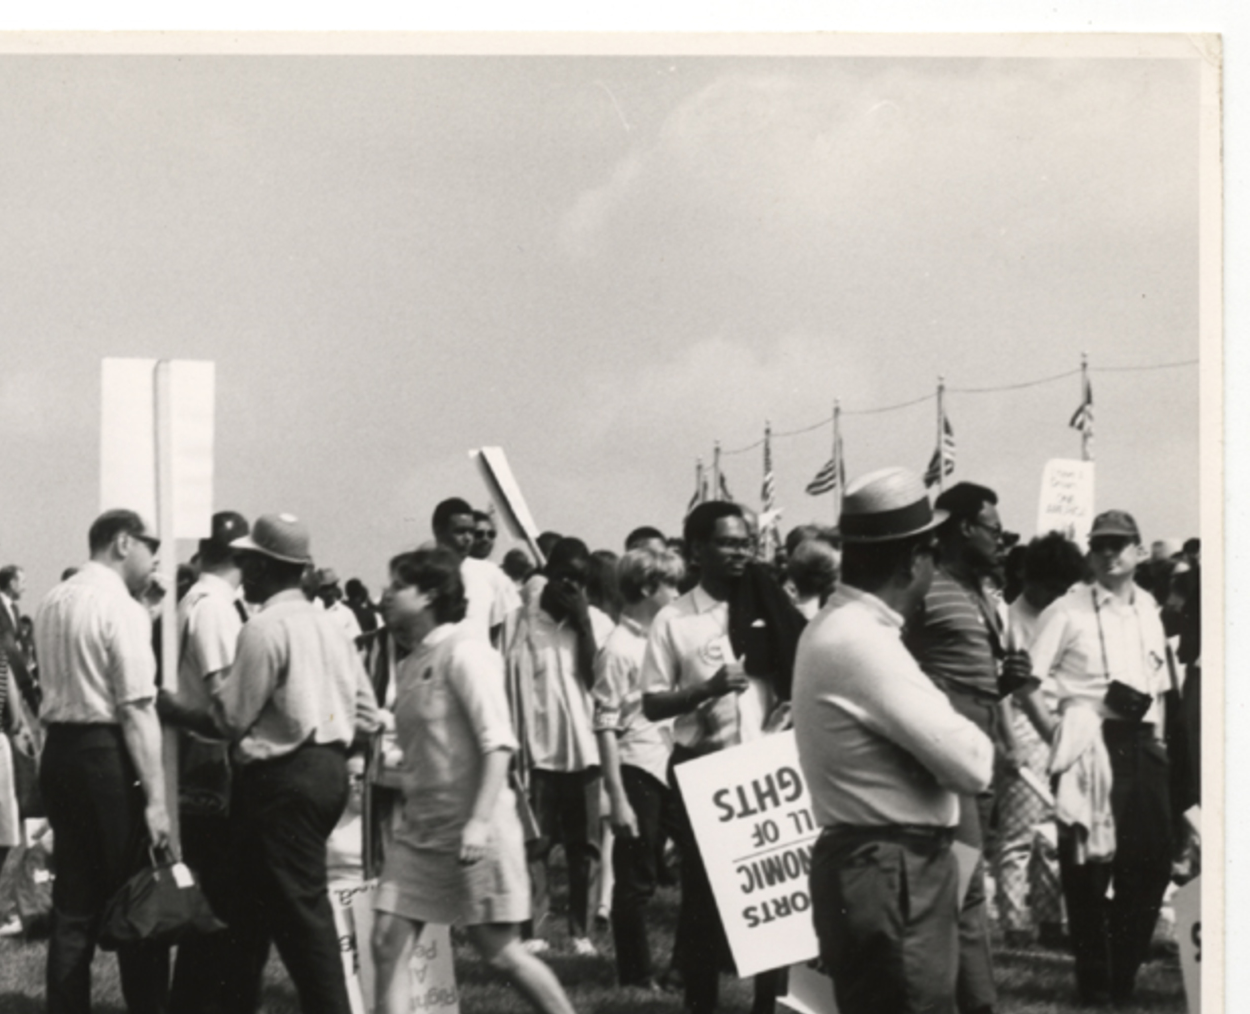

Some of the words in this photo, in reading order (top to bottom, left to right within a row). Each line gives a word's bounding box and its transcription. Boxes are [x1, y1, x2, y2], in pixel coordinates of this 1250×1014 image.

[712, 766, 804, 822] GHTS
[749, 820, 780, 848] OF
[742, 891, 810, 928] ORTS
